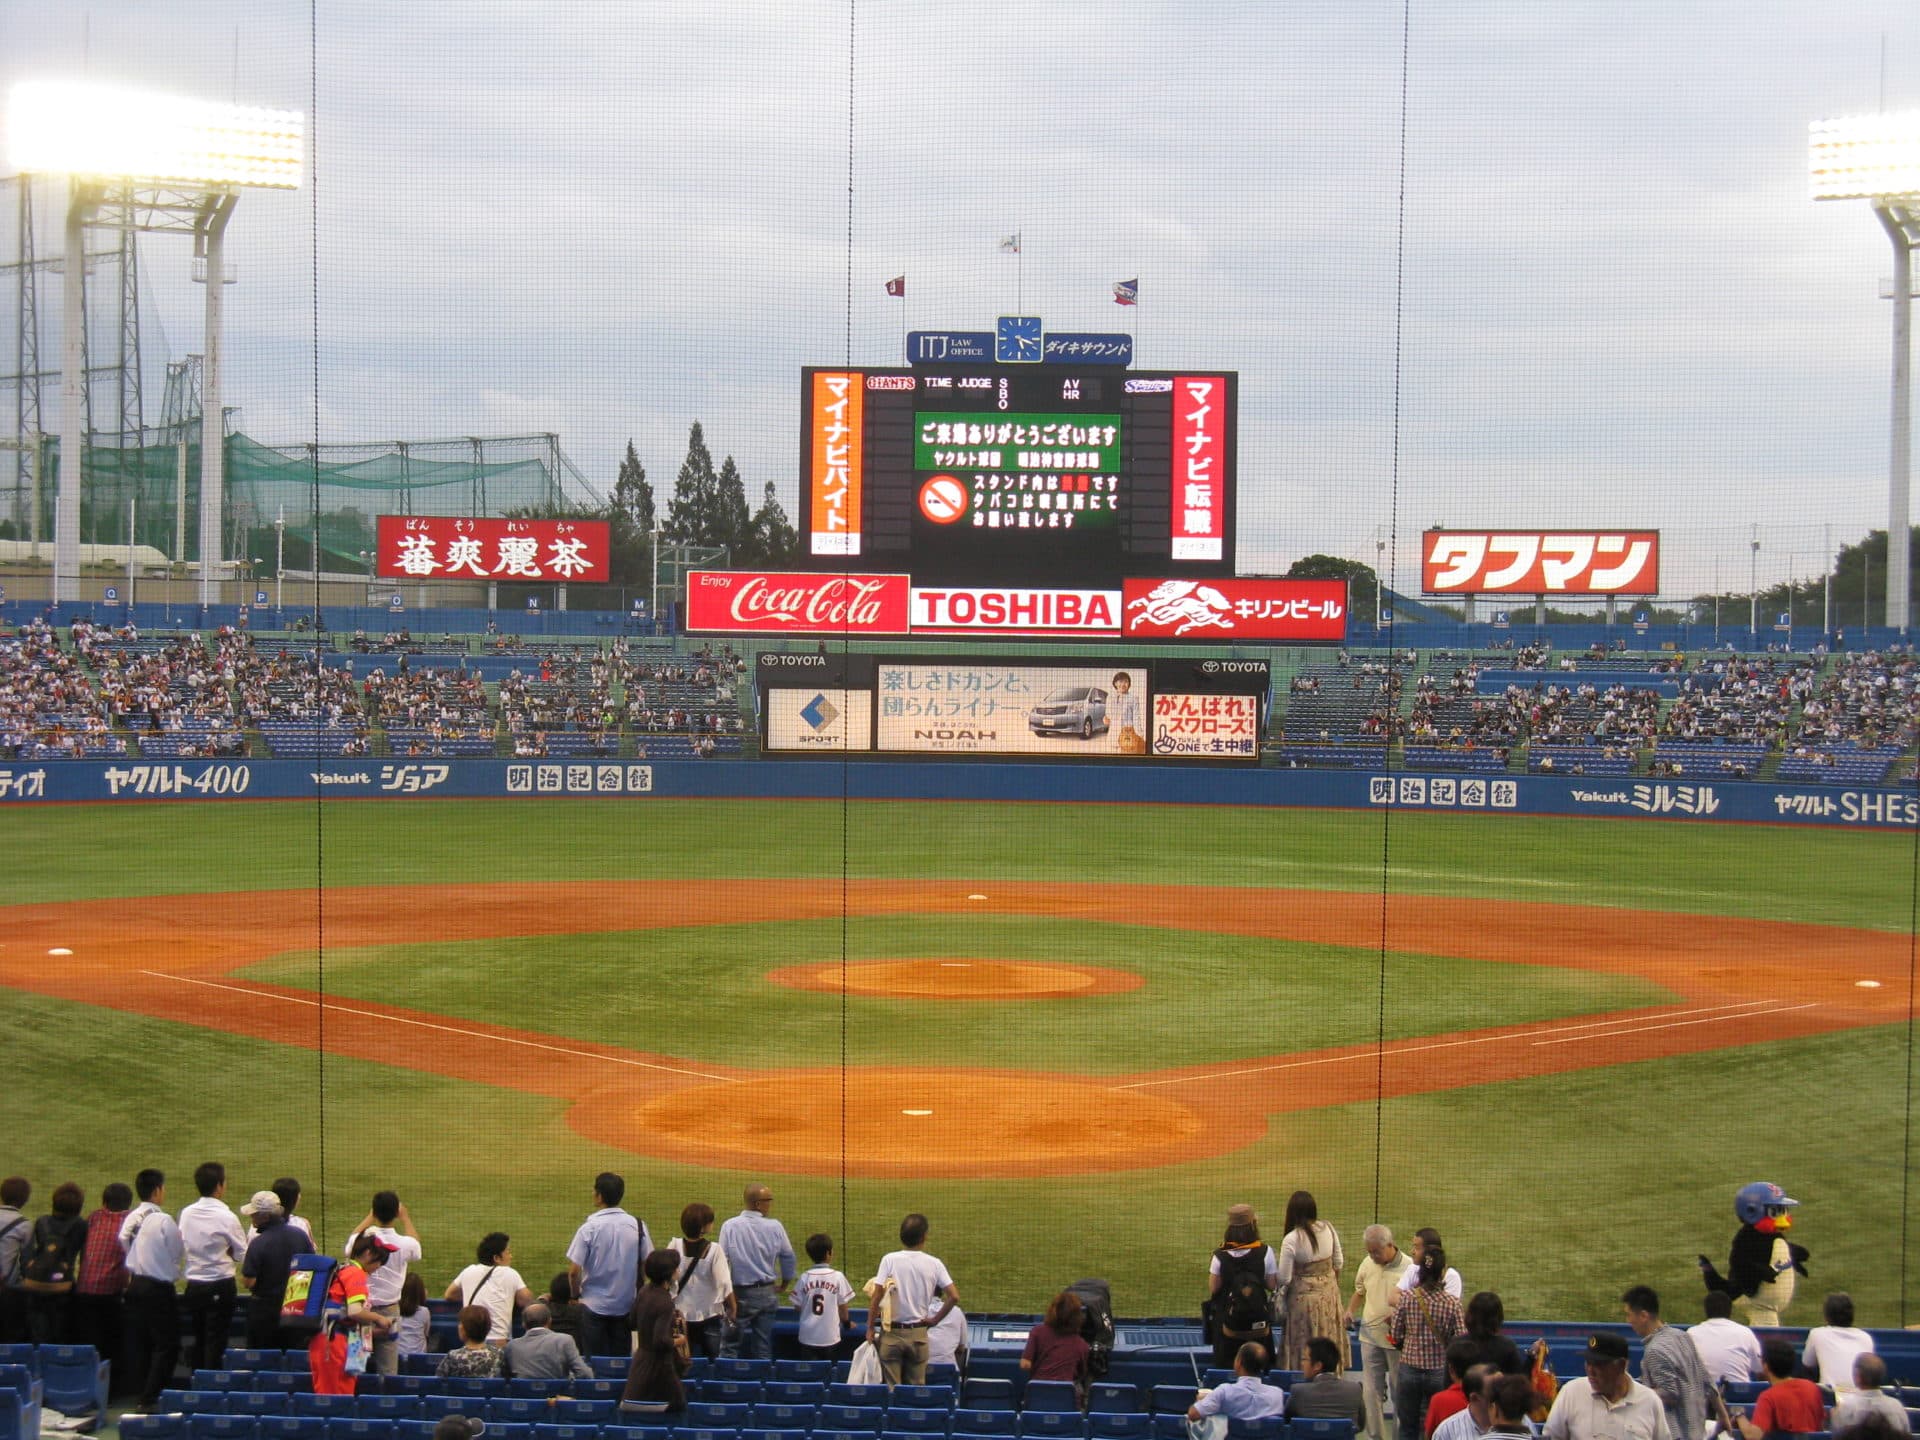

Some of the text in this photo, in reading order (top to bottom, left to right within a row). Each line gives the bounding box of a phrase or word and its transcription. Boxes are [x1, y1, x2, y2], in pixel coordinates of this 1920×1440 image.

[919, 336, 949, 358] ITJ
[951, 339, 972, 347] LAW
[951, 348, 984, 356] OFFICE
[1046, 341, 1131, 356] ダイキサウンド
[867, 375, 915, 390] GIANTS
[924, 377, 992, 388] TIME JUDGE
[1063, 379, 1080, 389] AV
[1063, 389, 1080, 400] HR
[921, 421, 1117, 447] ご来場ありがとうございます
[823, 377, 852, 531] マイナビバイト
[1183, 381, 1214, 534] マイナビ転職
[1429, 535, 1651, 589] タフマン
[700, 575, 732, 588] Enjoy
[634, 600, 644, 609] M
[730, 577, 889, 624] Coca-Cola
[919, 592, 1113, 625] TOSHIBA
[1234, 599, 1342, 619] キリンビール
[780, 655, 826, 666] TOYOTA
[1221, 661, 1268, 673] TOYOTA
[914, 730, 996, 740] NOAH
[310, 765, 449, 792] Yakult ジョア
[507, 765, 651, 791] 明治記念館
[1371, 777, 1516, 806] 明治記念館
[1571, 785, 1719, 814] Yakult ミルミル
[1775, 794, 1837, 815] ヤクルト
[812, 1293, 824, 1315] 6
